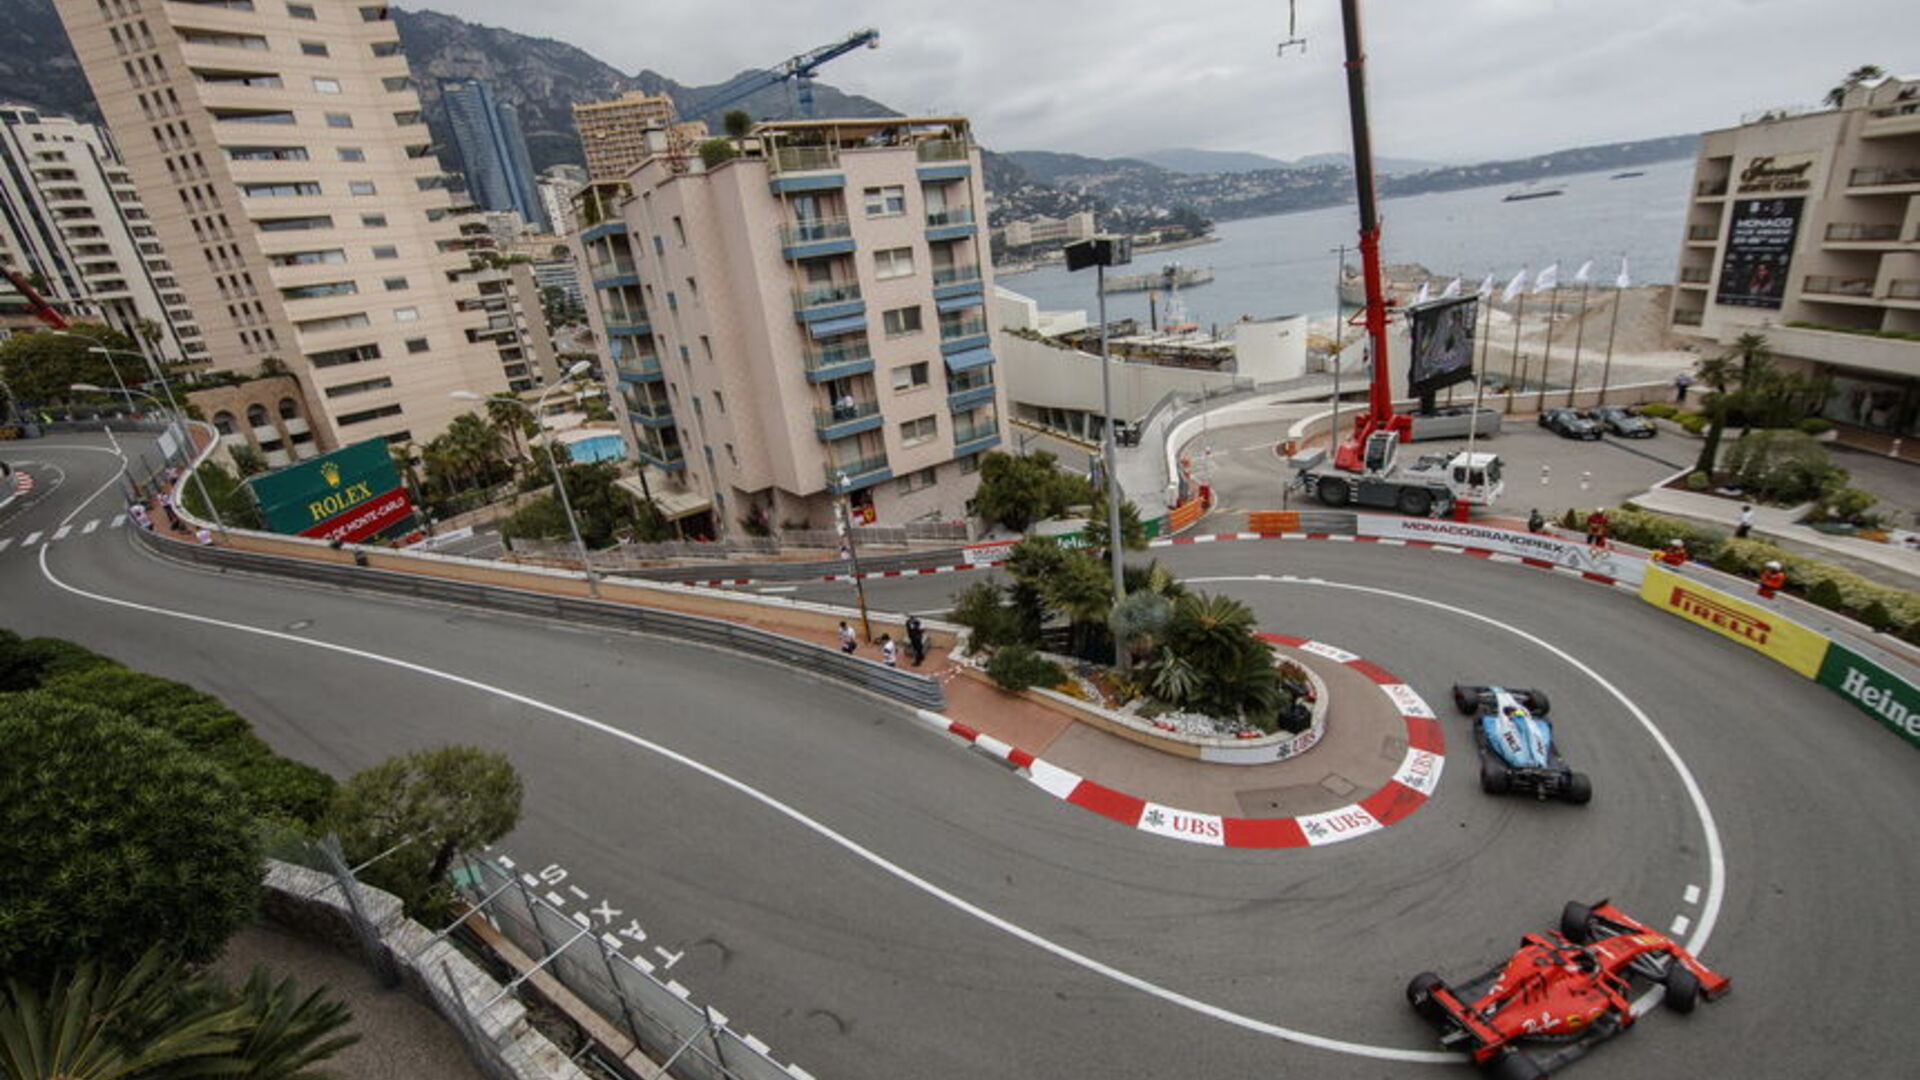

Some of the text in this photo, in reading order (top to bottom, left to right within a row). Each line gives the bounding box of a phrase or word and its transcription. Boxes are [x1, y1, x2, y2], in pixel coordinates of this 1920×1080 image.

[1736, 217, 1794, 228] MONACO
[308, 481, 373, 520] ROLEX
[345, 496, 405, 534] MONTE-CARLO
[1401, 520, 1564, 553] MONACOGRANDPRIX
[1669, 586, 1772, 645] PIRELLI
[1173, 815, 1221, 837] UBS
[1326, 807, 1373, 834] UBS
[539, 864, 685, 970] TAXIS
